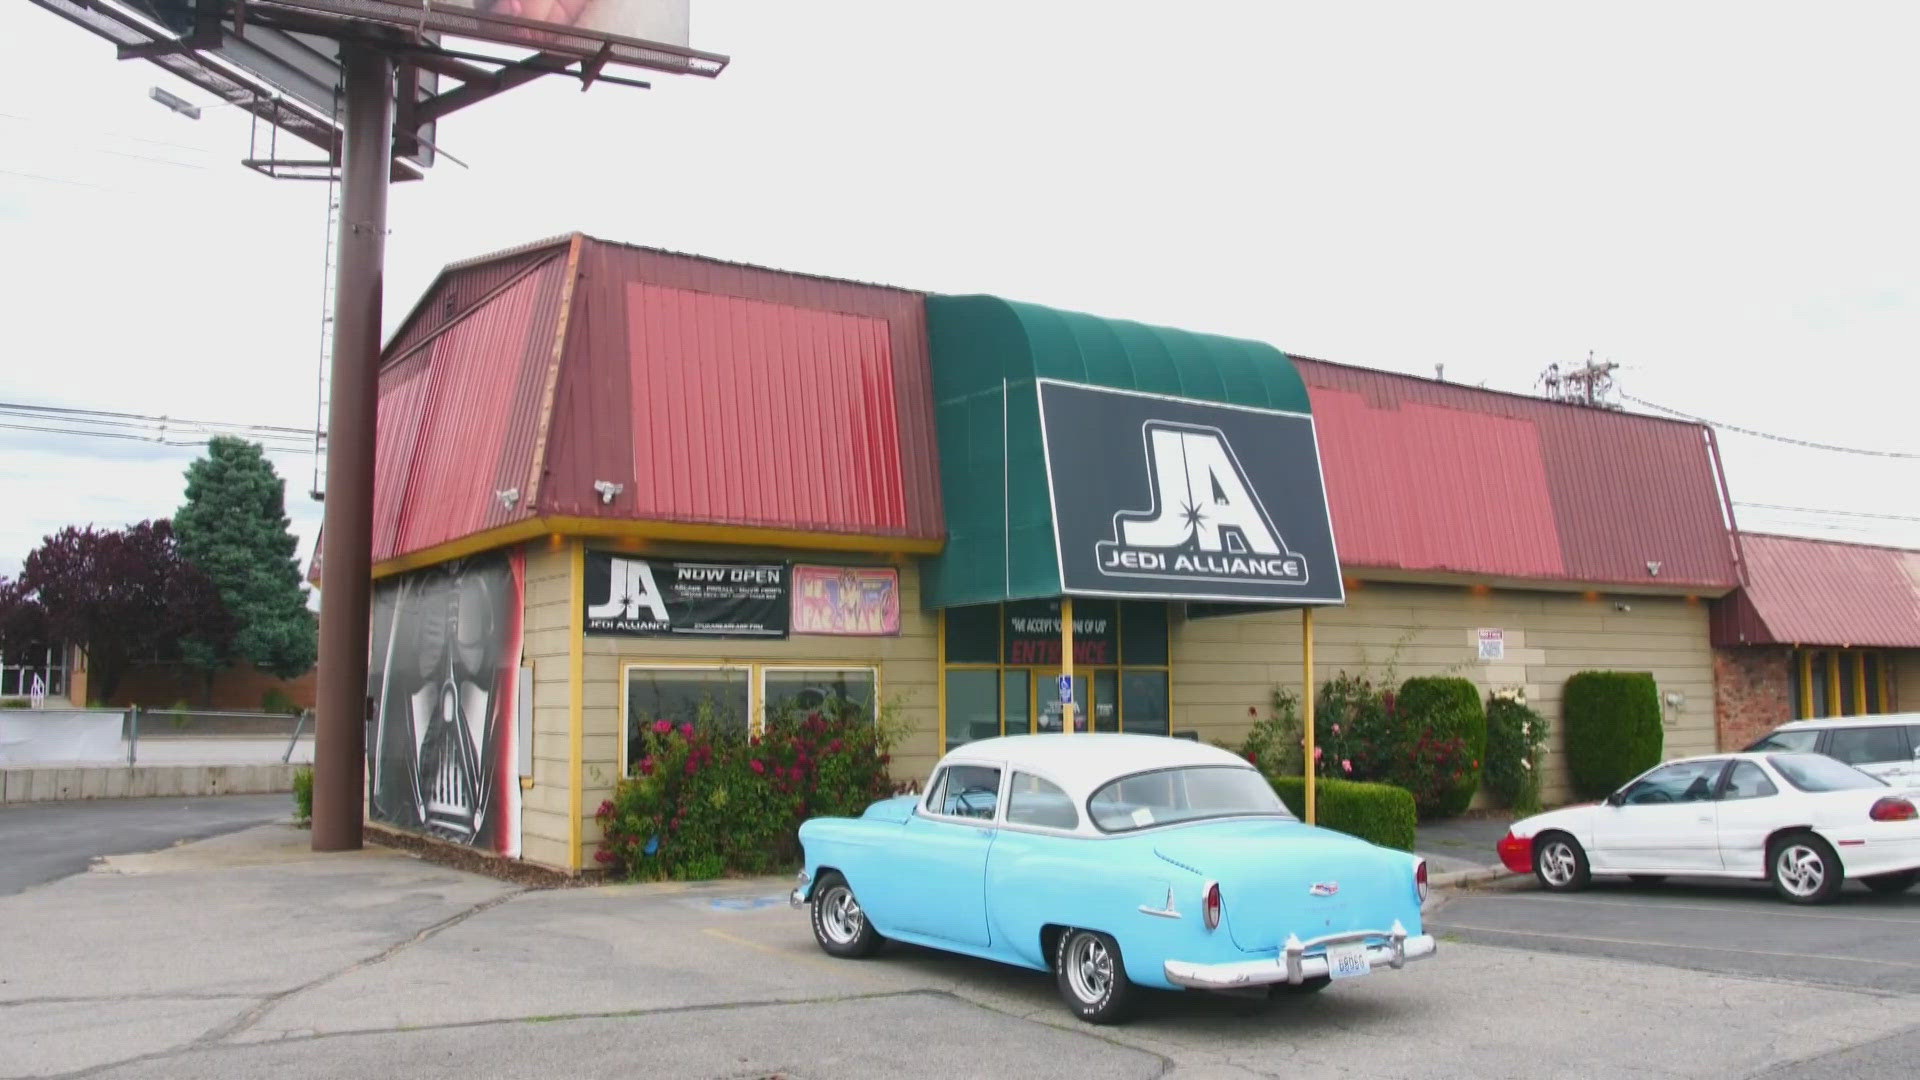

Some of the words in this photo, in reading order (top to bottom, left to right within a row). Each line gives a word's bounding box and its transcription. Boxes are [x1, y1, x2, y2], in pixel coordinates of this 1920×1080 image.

[1105, 550, 1167, 571] JEDI
[1174, 554, 1299, 577] ALLIANCE
[678, 567, 725, 582] NOW
[730, 568, 780, 584] OPEN
[589, 620, 614, 630] JEDI
[616, 621, 669, 631] ALLIANCE
[1027, 617, 1053, 633] ACCEPT
[1084, 620, 1095, 634] OF
[1011, 639, 1108, 665] ENTRNCE
